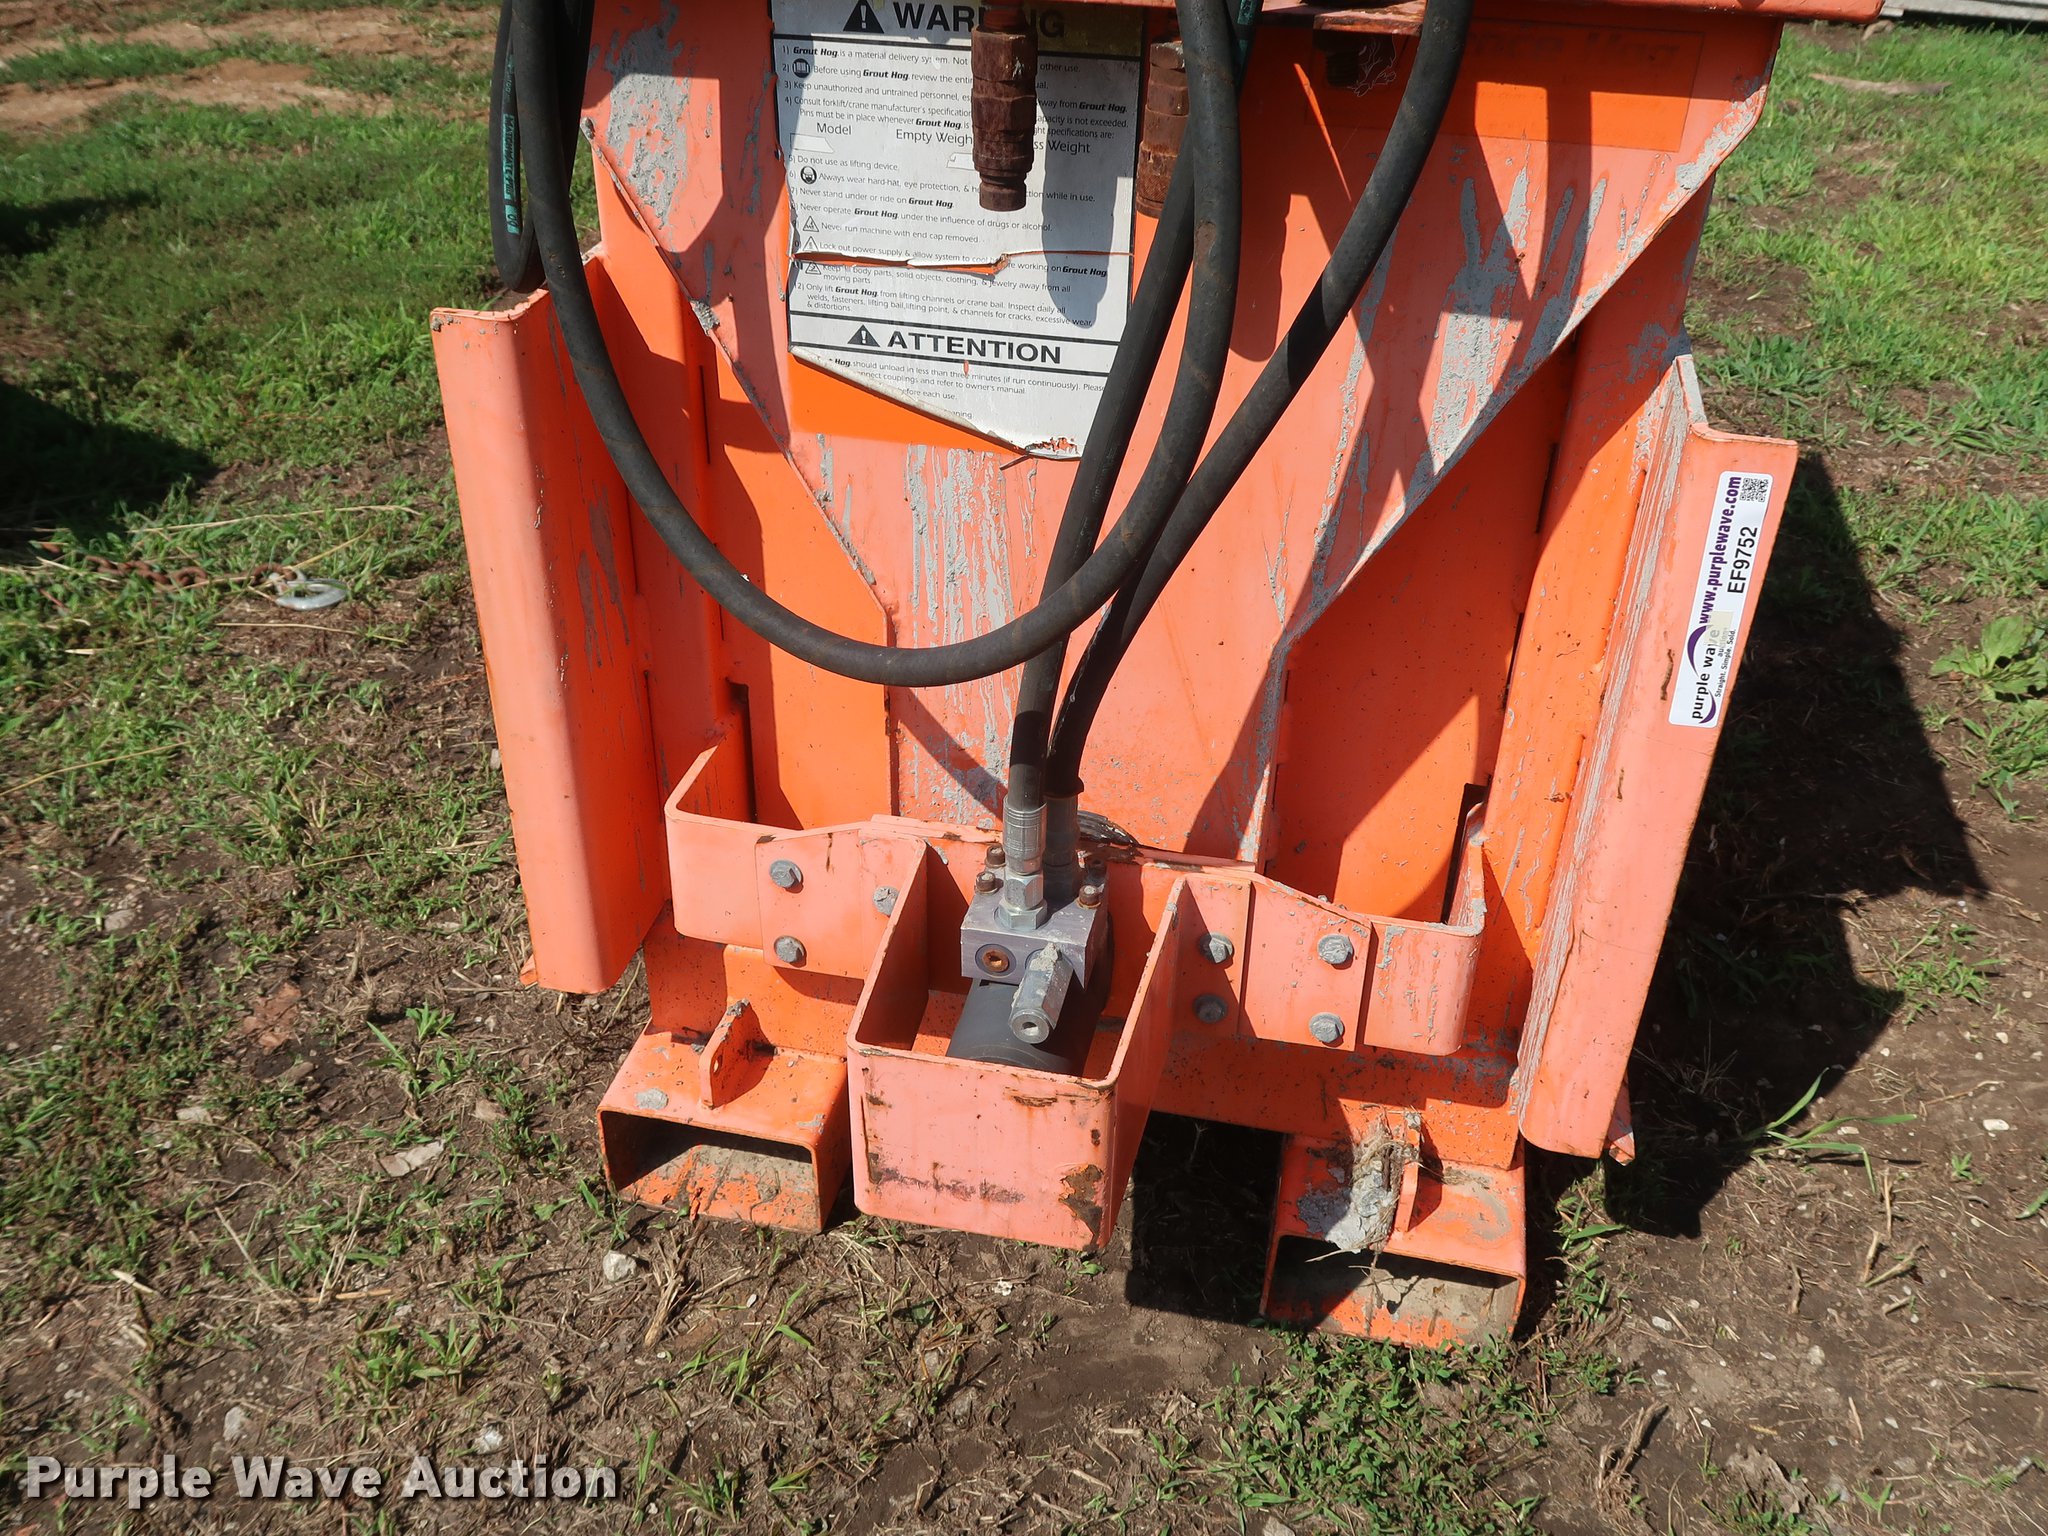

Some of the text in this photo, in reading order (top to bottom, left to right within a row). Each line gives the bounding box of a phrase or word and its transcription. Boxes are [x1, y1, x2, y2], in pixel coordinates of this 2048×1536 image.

[936, 132, 972, 144] Weigh
[887, 331, 1061, 364] ATTENTION
[1700, 477, 1742, 624] www.purplewave.com
[1727, 526, 1757, 593] EF9752
[1715, 628, 1736, 697] Straight. Simple. Sold.
[1692, 673, 1711, 719] purple
